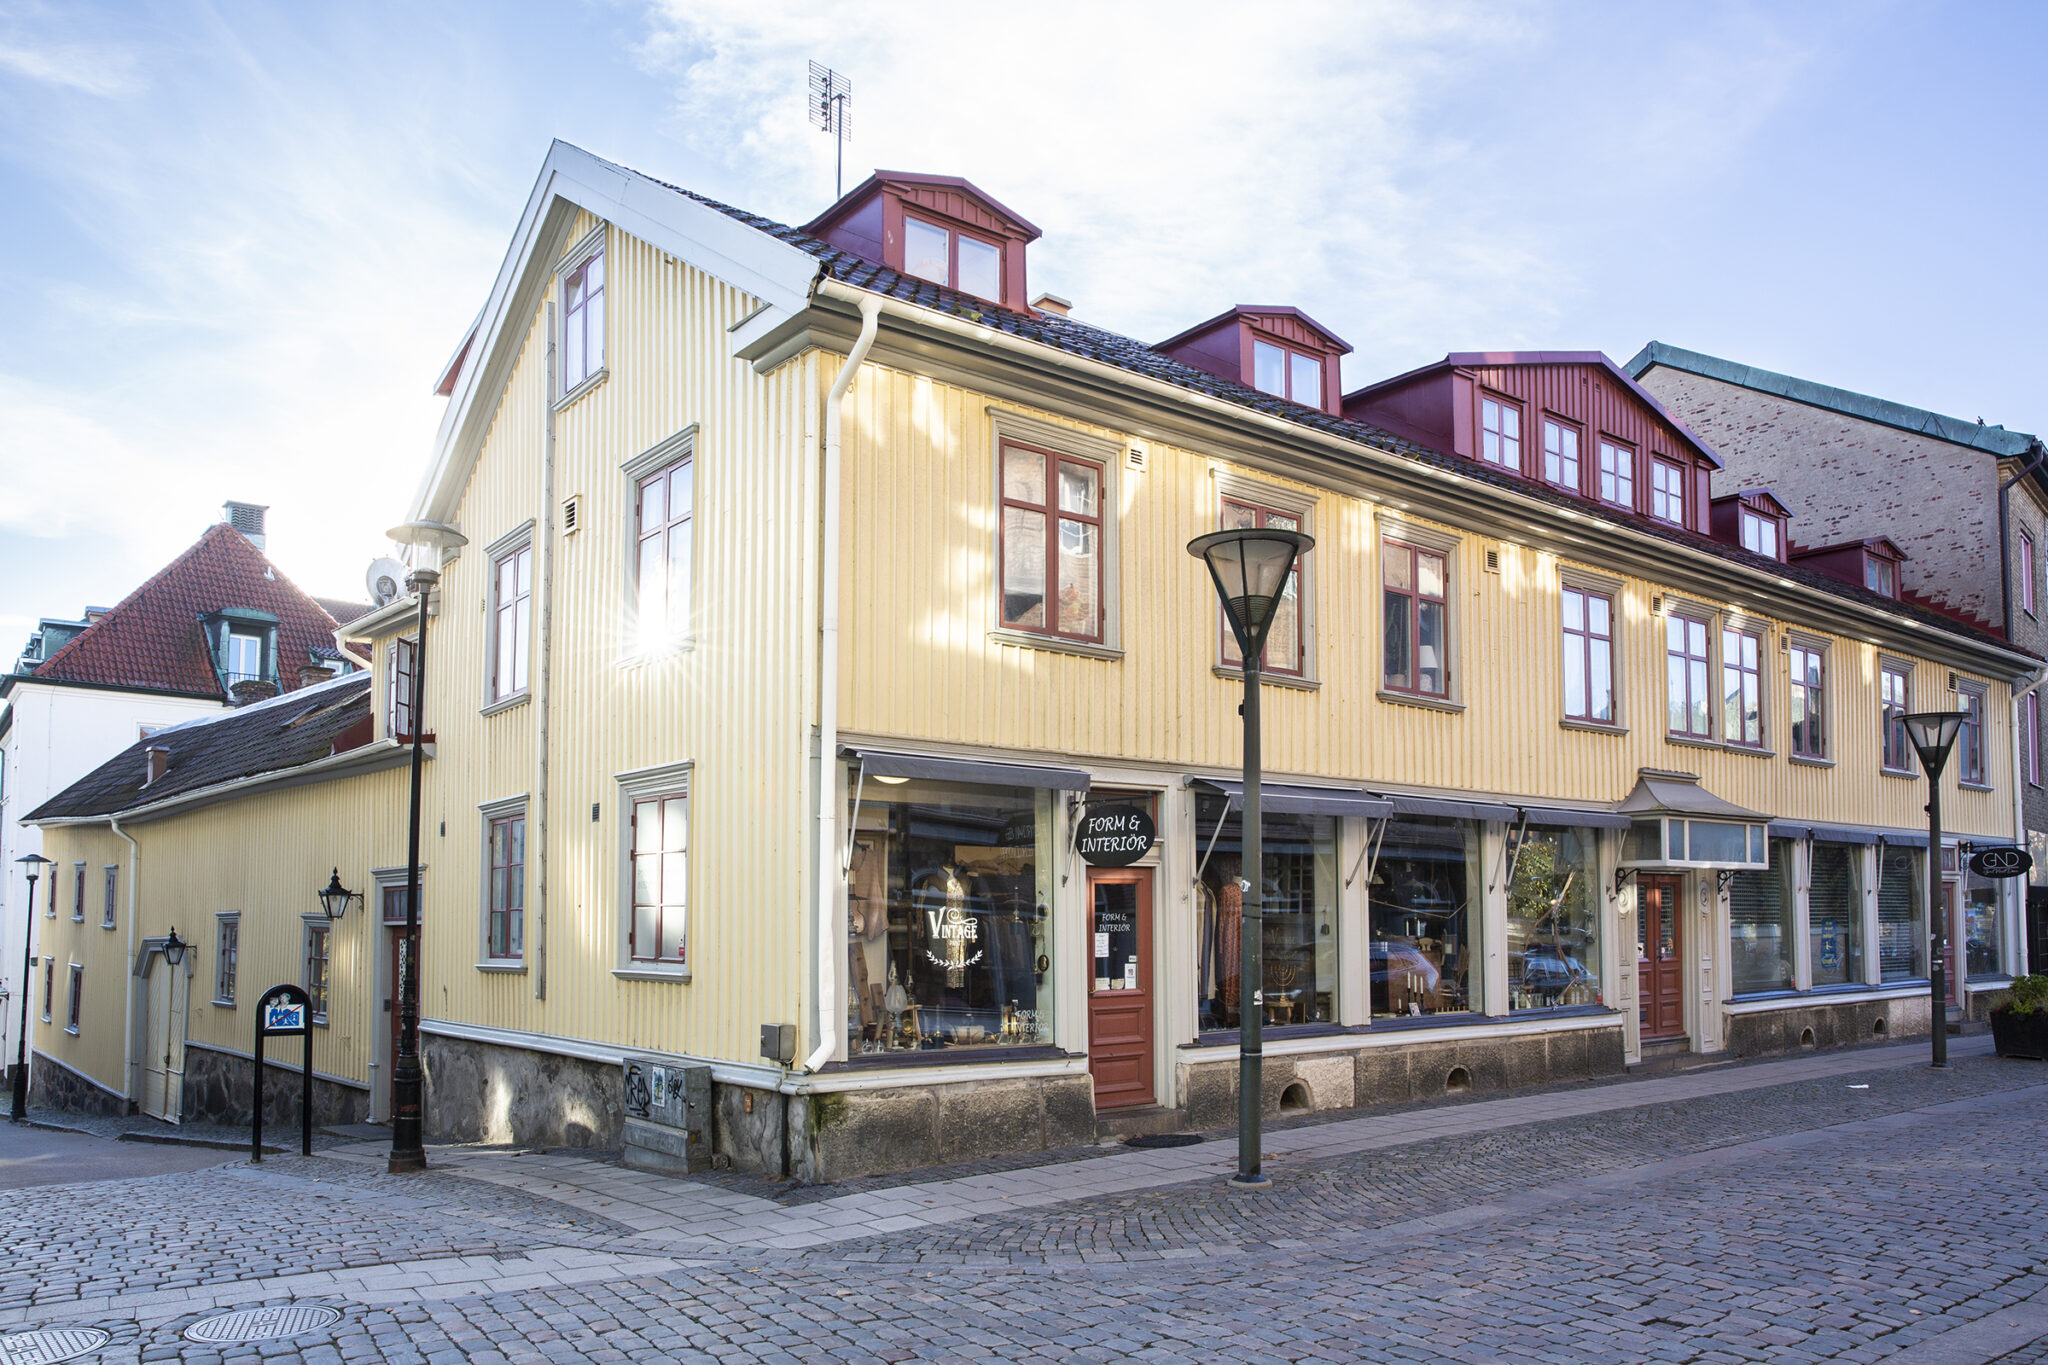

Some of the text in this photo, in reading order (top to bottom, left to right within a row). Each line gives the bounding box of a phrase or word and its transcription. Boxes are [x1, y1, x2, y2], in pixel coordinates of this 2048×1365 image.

[1088, 815, 1141, 834] FORM &
[1081, 834, 1147, 853] INTERIÖR
[1982, 852, 2020, 868] GND
[1101, 912, 1121, 922] FORM
